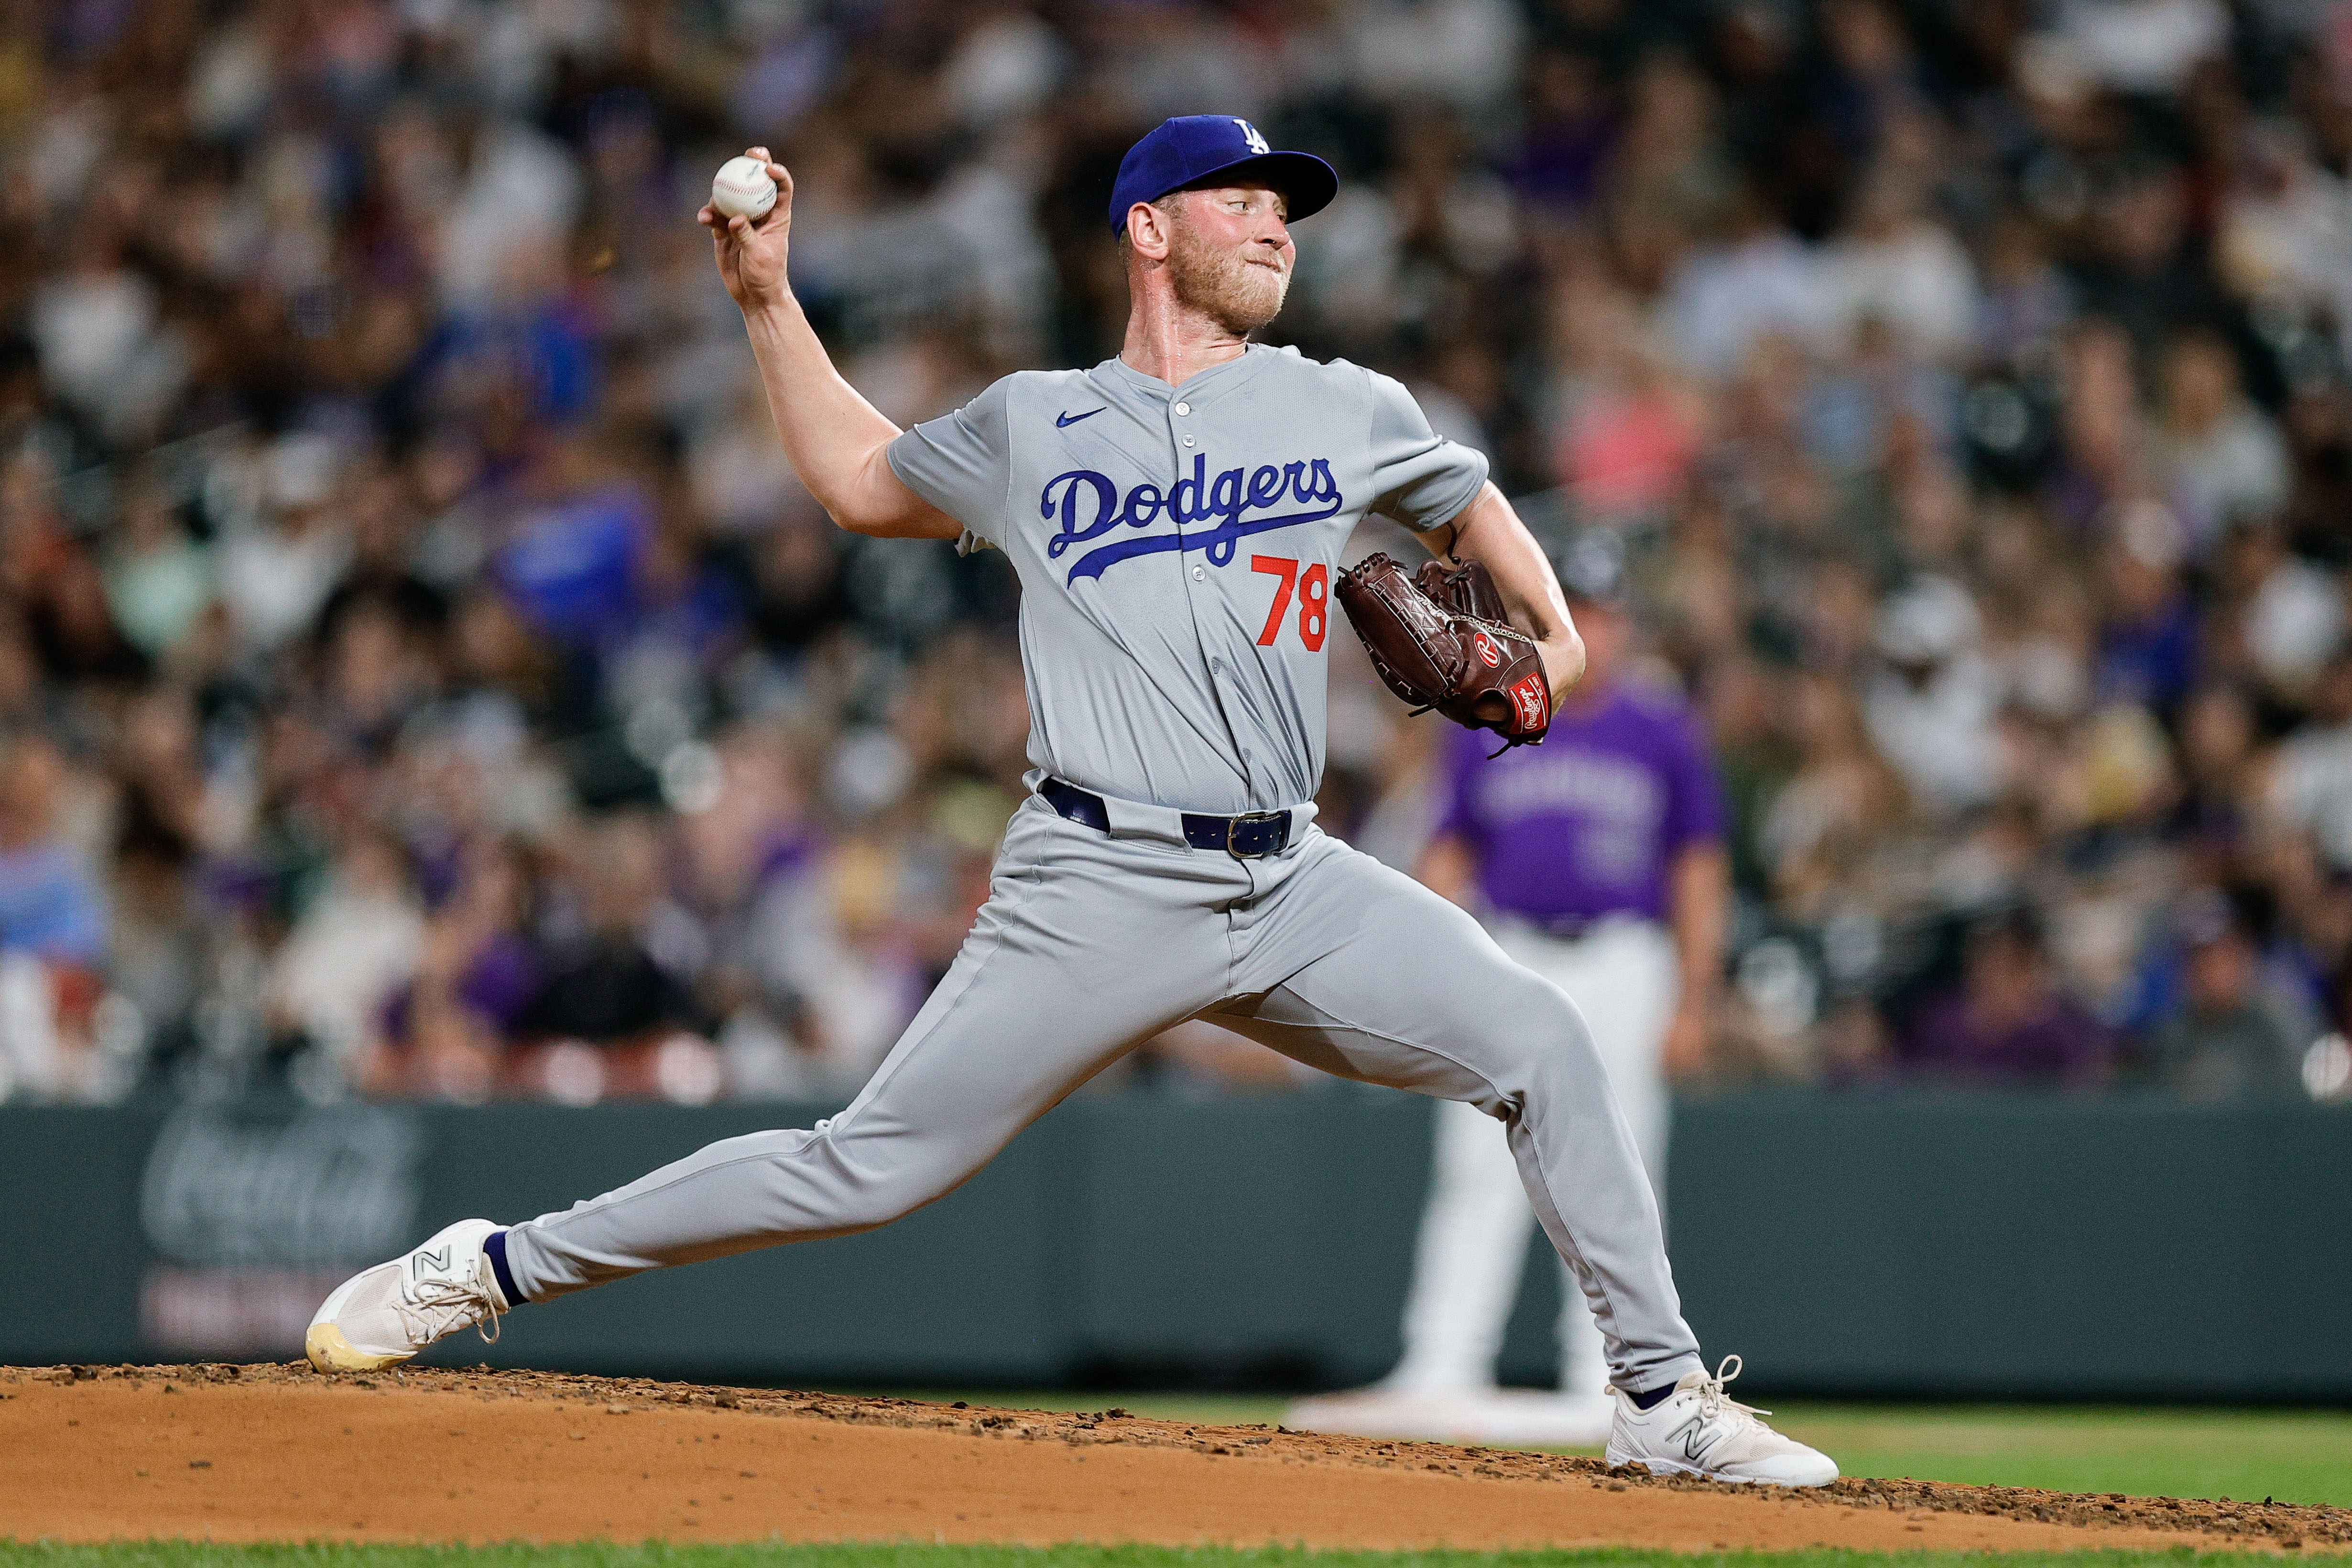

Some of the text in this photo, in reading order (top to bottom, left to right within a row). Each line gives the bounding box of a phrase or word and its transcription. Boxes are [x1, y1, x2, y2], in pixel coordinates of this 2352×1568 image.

[1233, 119, 1270, 154] LA
[1041, 453, 1342, 588] Dodgers
[1251, 554, 1328, 652] 78
[1519, 687, 1537, 729] Rawlings
